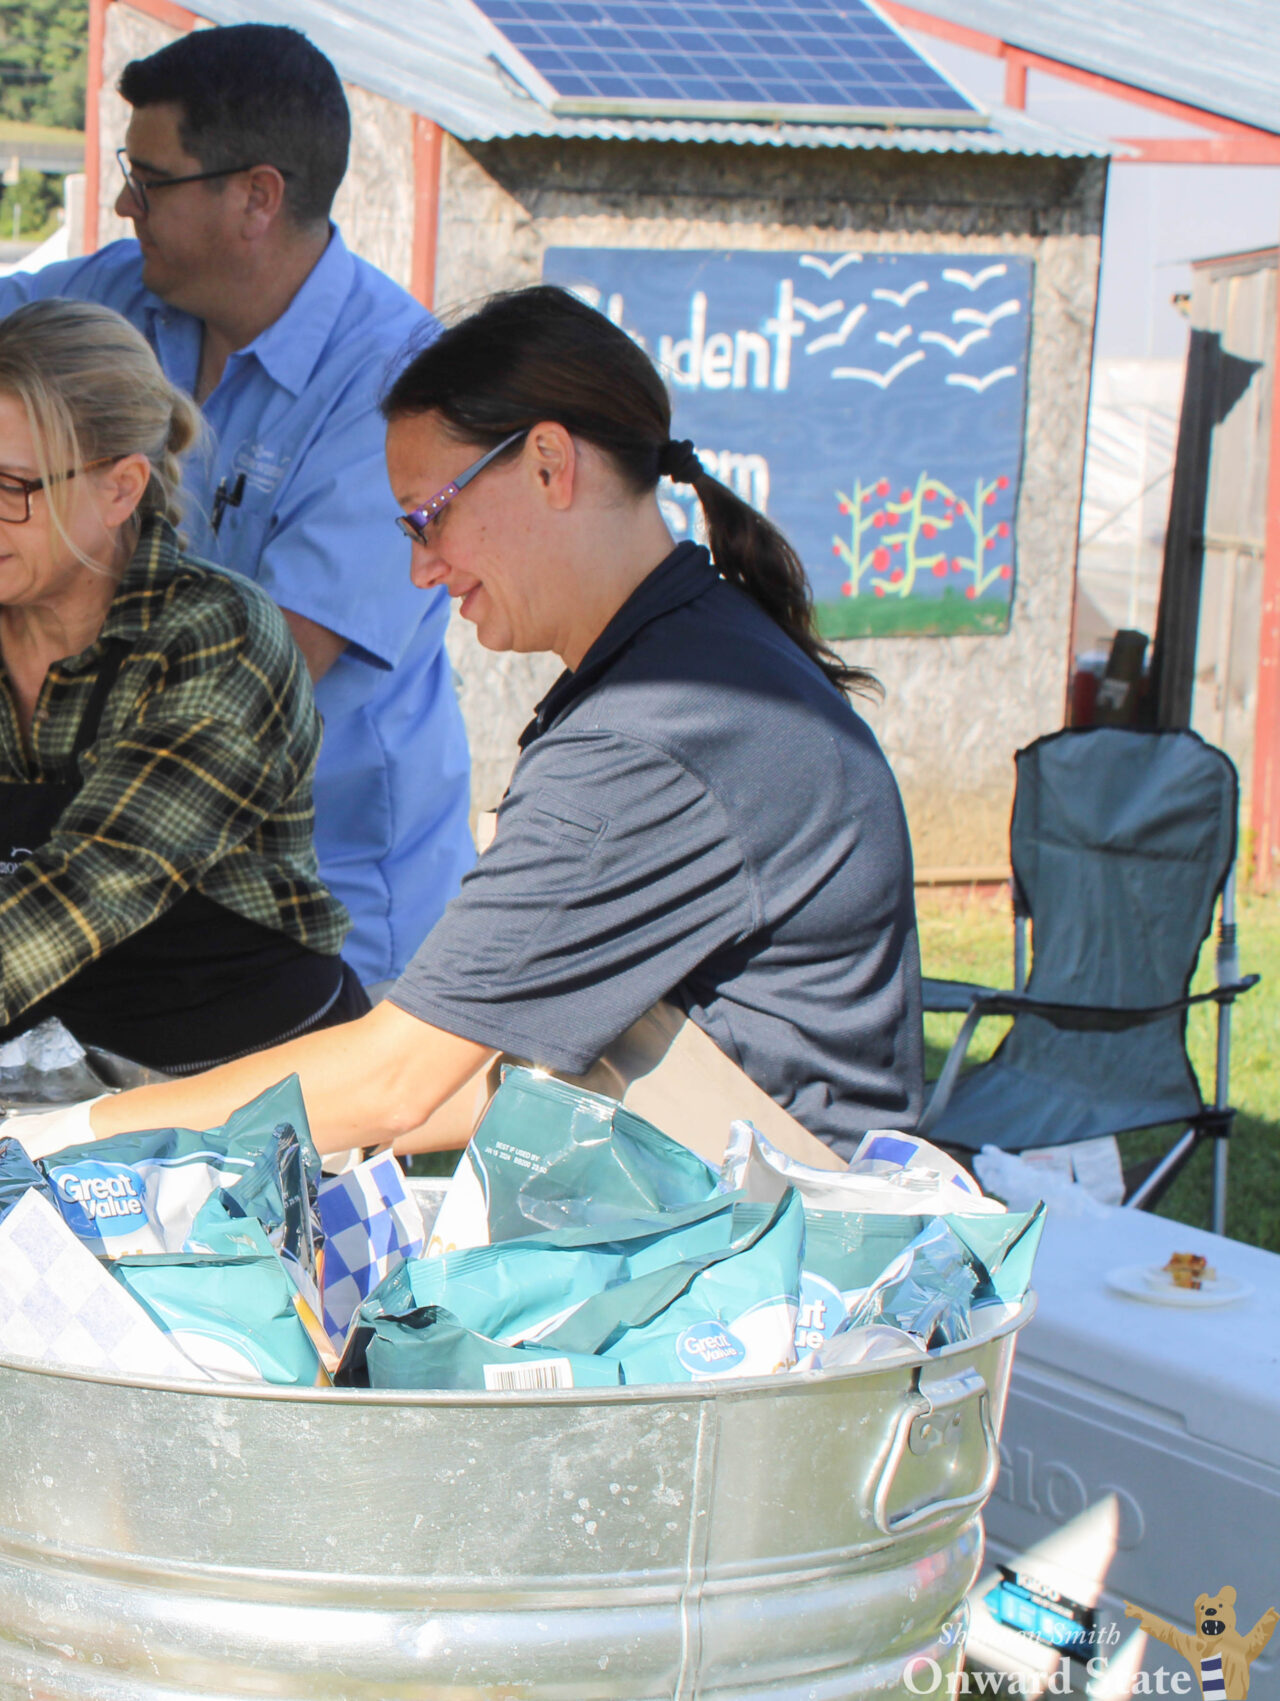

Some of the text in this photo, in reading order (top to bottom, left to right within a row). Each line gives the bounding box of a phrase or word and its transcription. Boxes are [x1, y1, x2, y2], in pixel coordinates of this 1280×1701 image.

[57, 1173, 138, 1204] Great
[79, 1195, 143, 1221] Value
[685, 1333, 732, 1354] Great
[700, 1346, 738, 1363] Value
